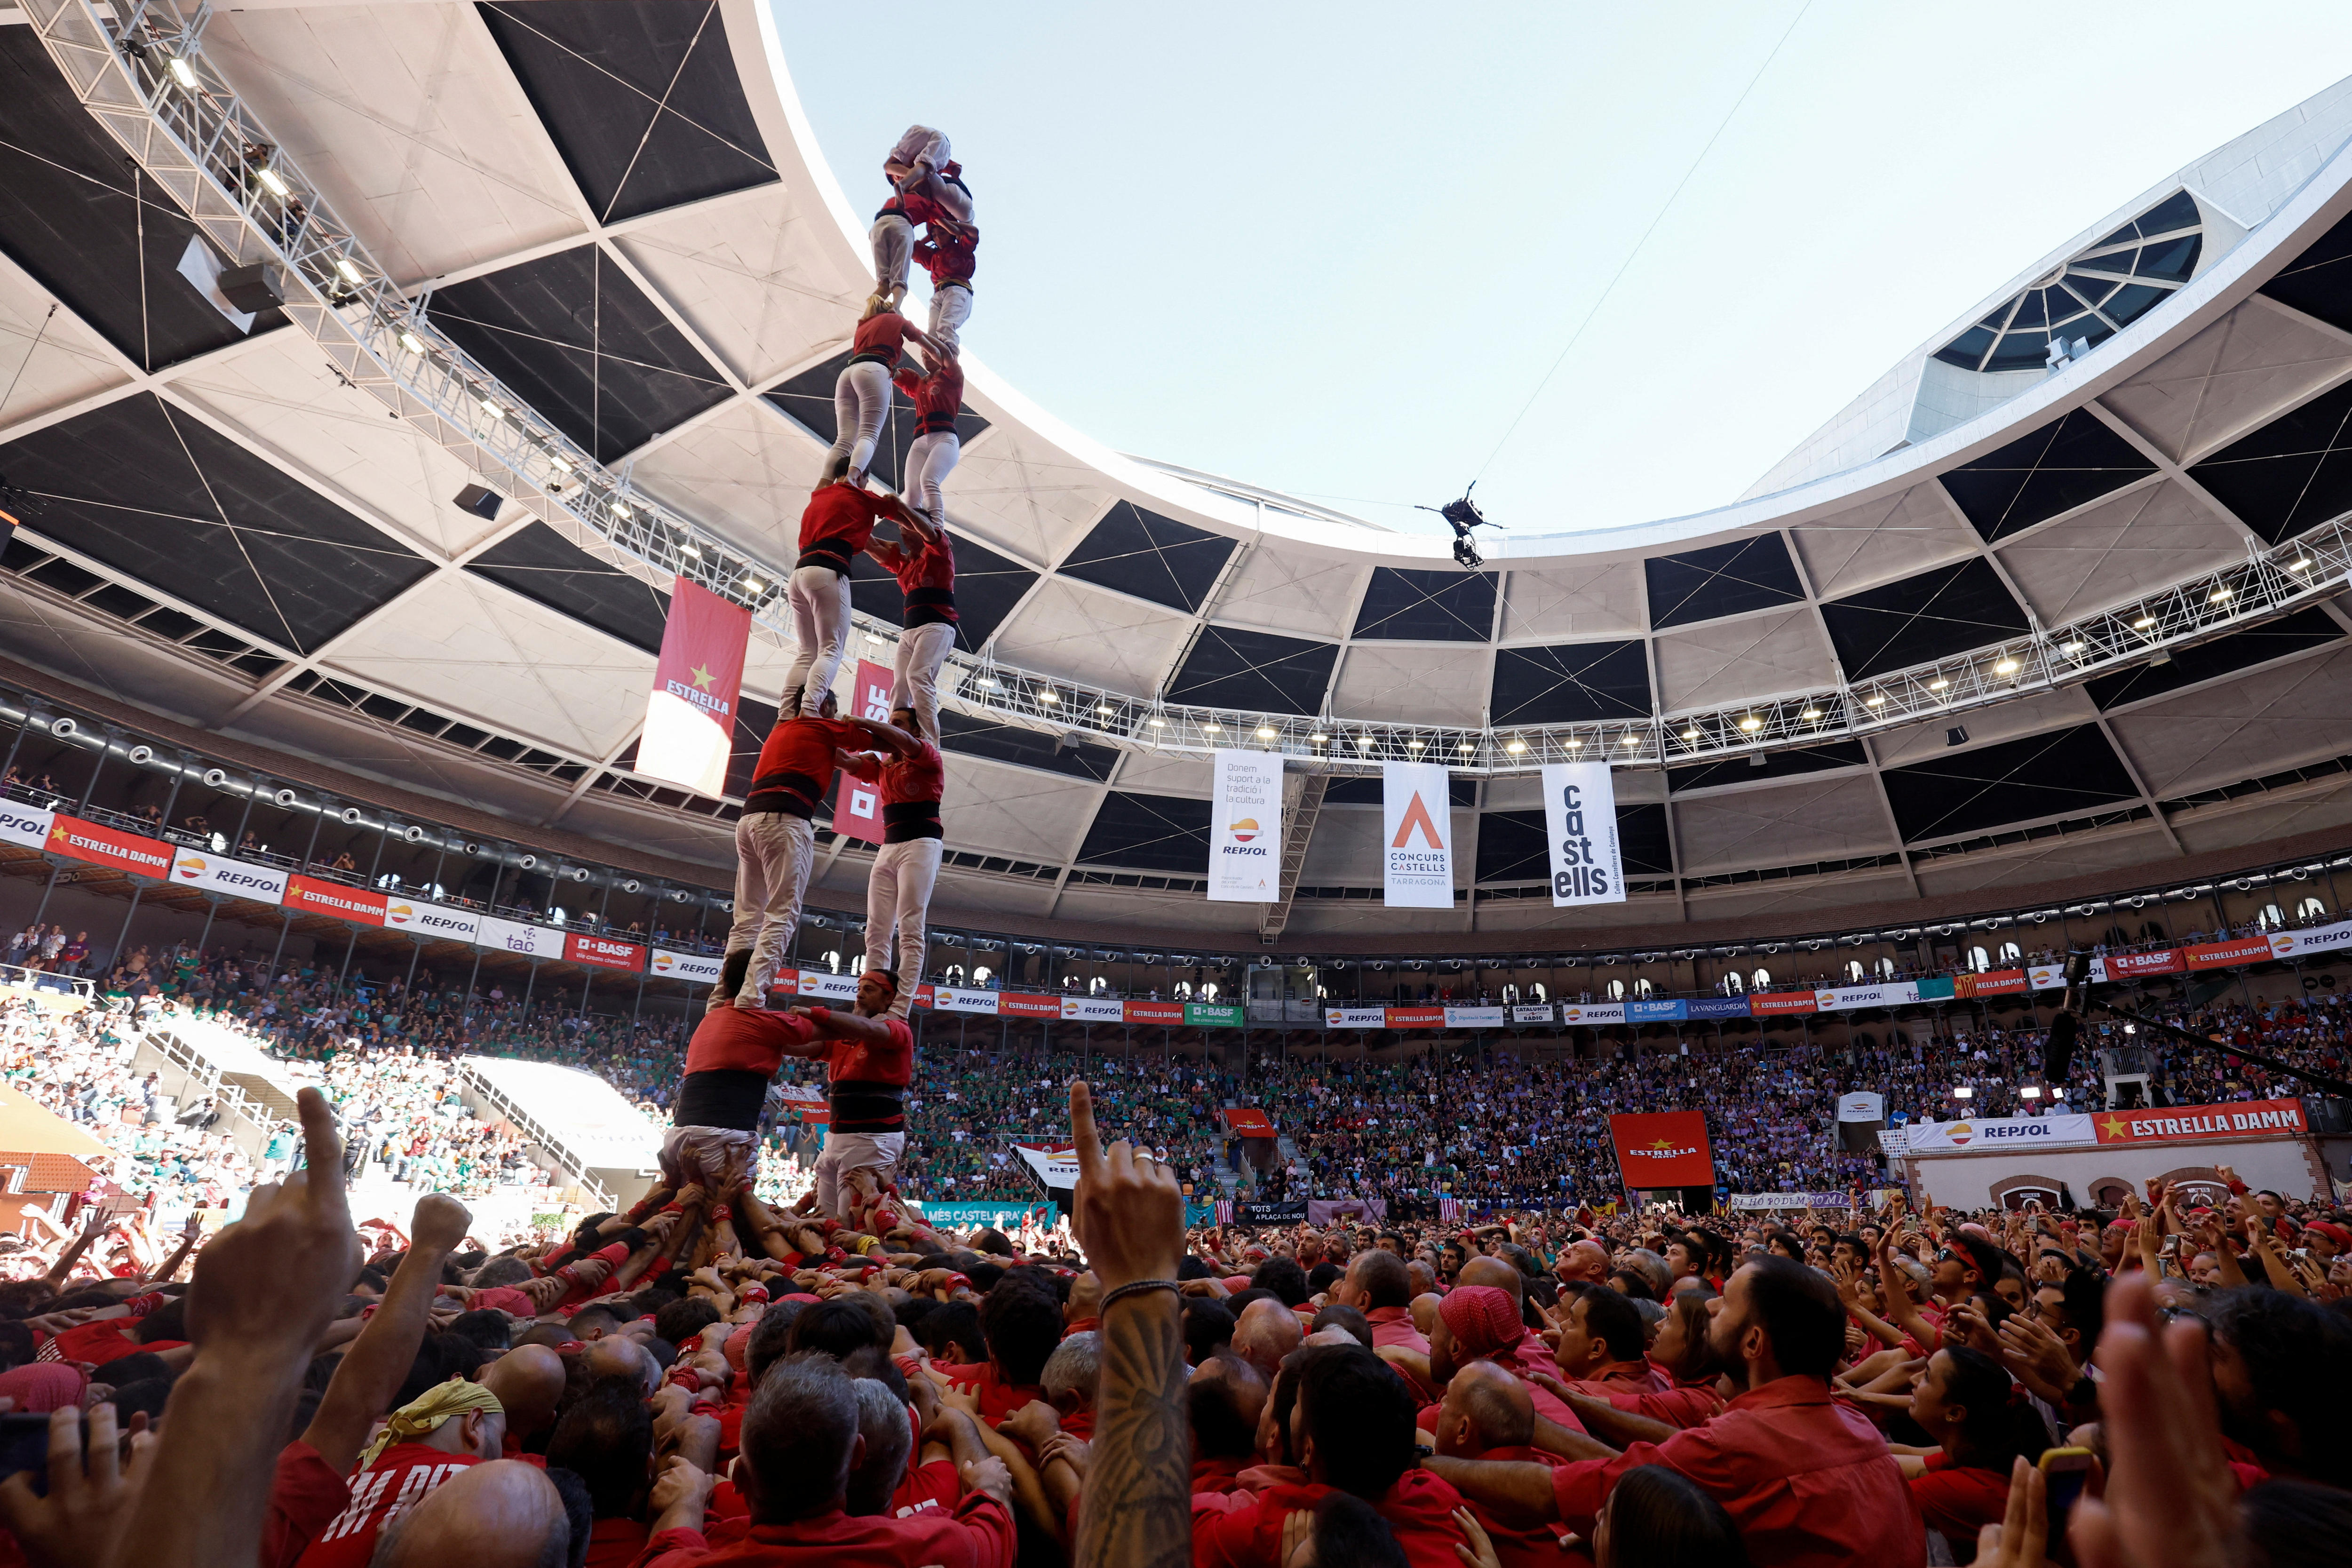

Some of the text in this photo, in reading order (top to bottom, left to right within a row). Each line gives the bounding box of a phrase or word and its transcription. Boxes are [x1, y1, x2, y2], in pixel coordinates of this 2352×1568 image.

[666, 679, 729, 715] ESTRELLA
[1228, 764, 1256, 772] Donem
[1227, 775, 1253, 784] suport
[1227, 785, 1257, 794] tradició
[1236, 796, 1264, 804] cultura
[0, 813, 45, 836] PSOL
[69, 835, 168, 868] ESTRELLA DAMM
[1223, 846, 1267, 856] REPSOL
[1391, 853, 1445, 861] CONCURS
[1391, 863, 1445, 872] CASTELLS
[215, 870, 281, 893] REPSOL
[302, 891, 384, 916] ESTRELLA DAMM
[421, 915, 475, 933] REPSOL
[2304, 930, 2352, 945] REPSO
[506, 934, 534, 952] tac
[597, 942, 633, 957] BASF
[2199, 945, 2269, 962] ESTRELLA DAMM
[604, 957, 631, 967] chemistry
[2136, 953, 2171, 965] BASF
[680, 963, 722, 975] REPSO
[774, 978, 796, 986] DAMM
[1977, 978, 2023, 989] RELLA DAMM
[824, 983, 858, 993] REPSO
[958, 997, 996, 1007] REPSOL
[1842, 993, 1882, 1002] REPSOL
[1009, 1002, 1038, 1011] ESTRELLA
[1649, 1003, 1676, 1012] BASF
[1700, 1003, 1747, 1011] VANGUARDIA
[1207, 1008, 1233, 1017] BASF
[2131, 1109, 2300, 1137] ESTRELLA DAMM
[1985, 1124, 2051, 1138] REPSOL
[1629, 1147, 1697, 1156] ESTRELLA
[1767, 1196, 1805, 1206] PODEM
[928, 1208, 952, 1221] MÉS
